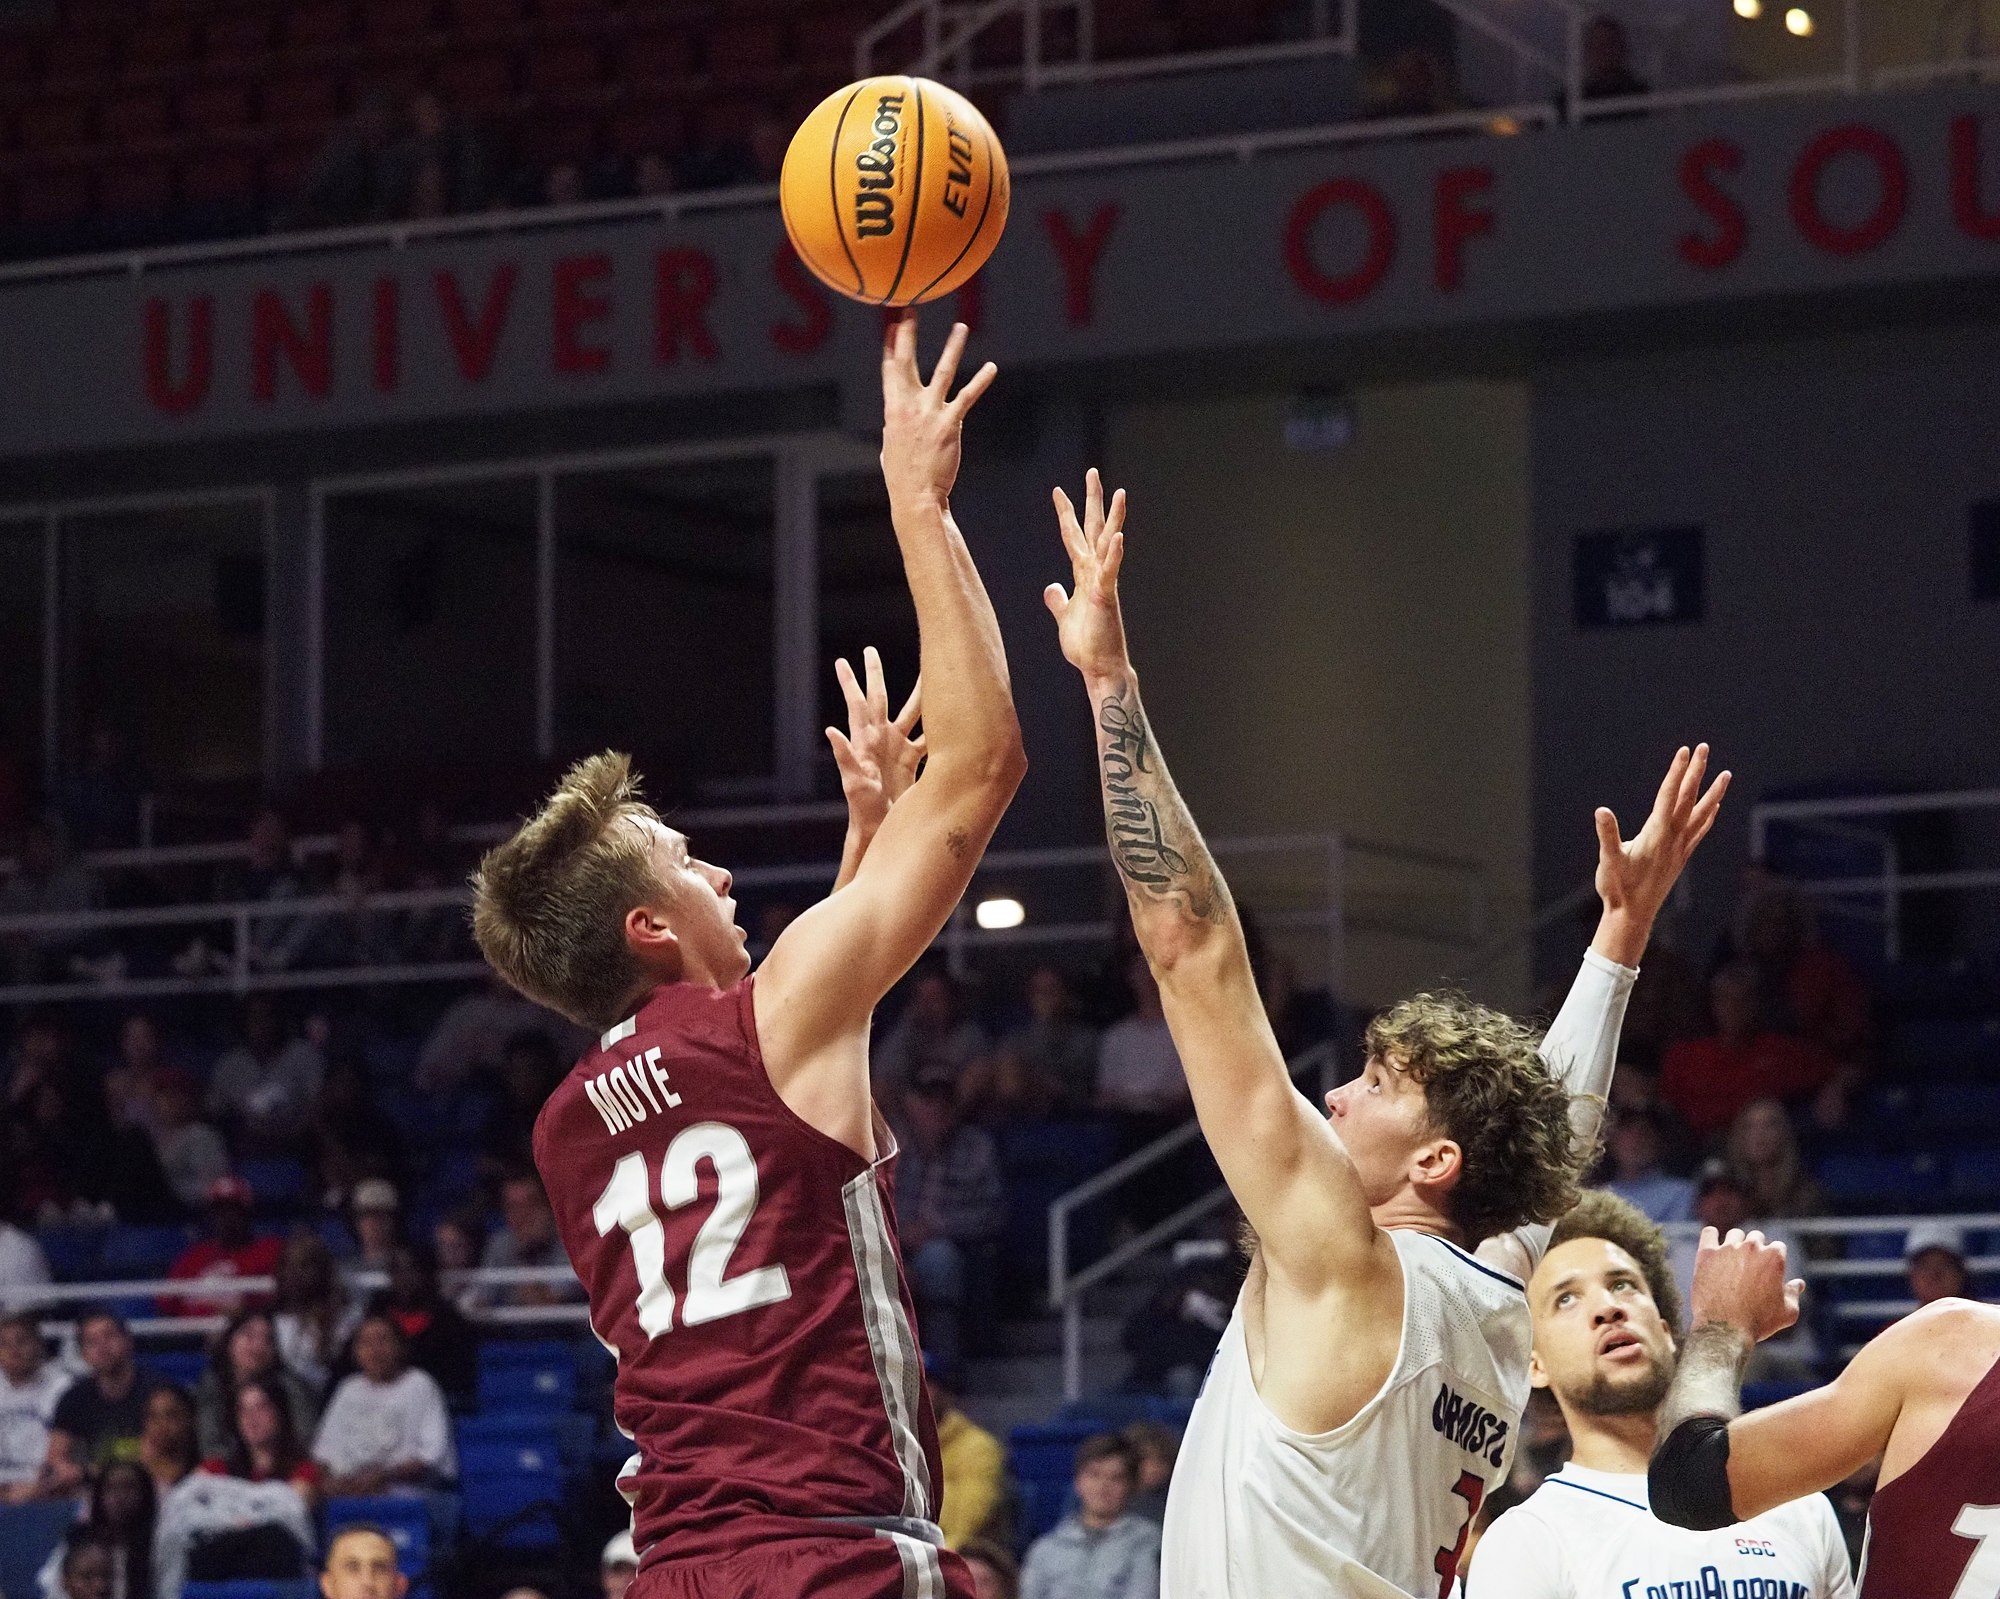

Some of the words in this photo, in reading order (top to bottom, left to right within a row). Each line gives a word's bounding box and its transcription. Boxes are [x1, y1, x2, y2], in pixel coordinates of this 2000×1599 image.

[855, 91, 906, 241] Wilson
[143, 202, 1122, 414] UNIVERSY
[1281, 165, 1494, 306] OF
[584, 1046, 683, 1136] MOYE
[592, 1121, 793, 1342] 12
